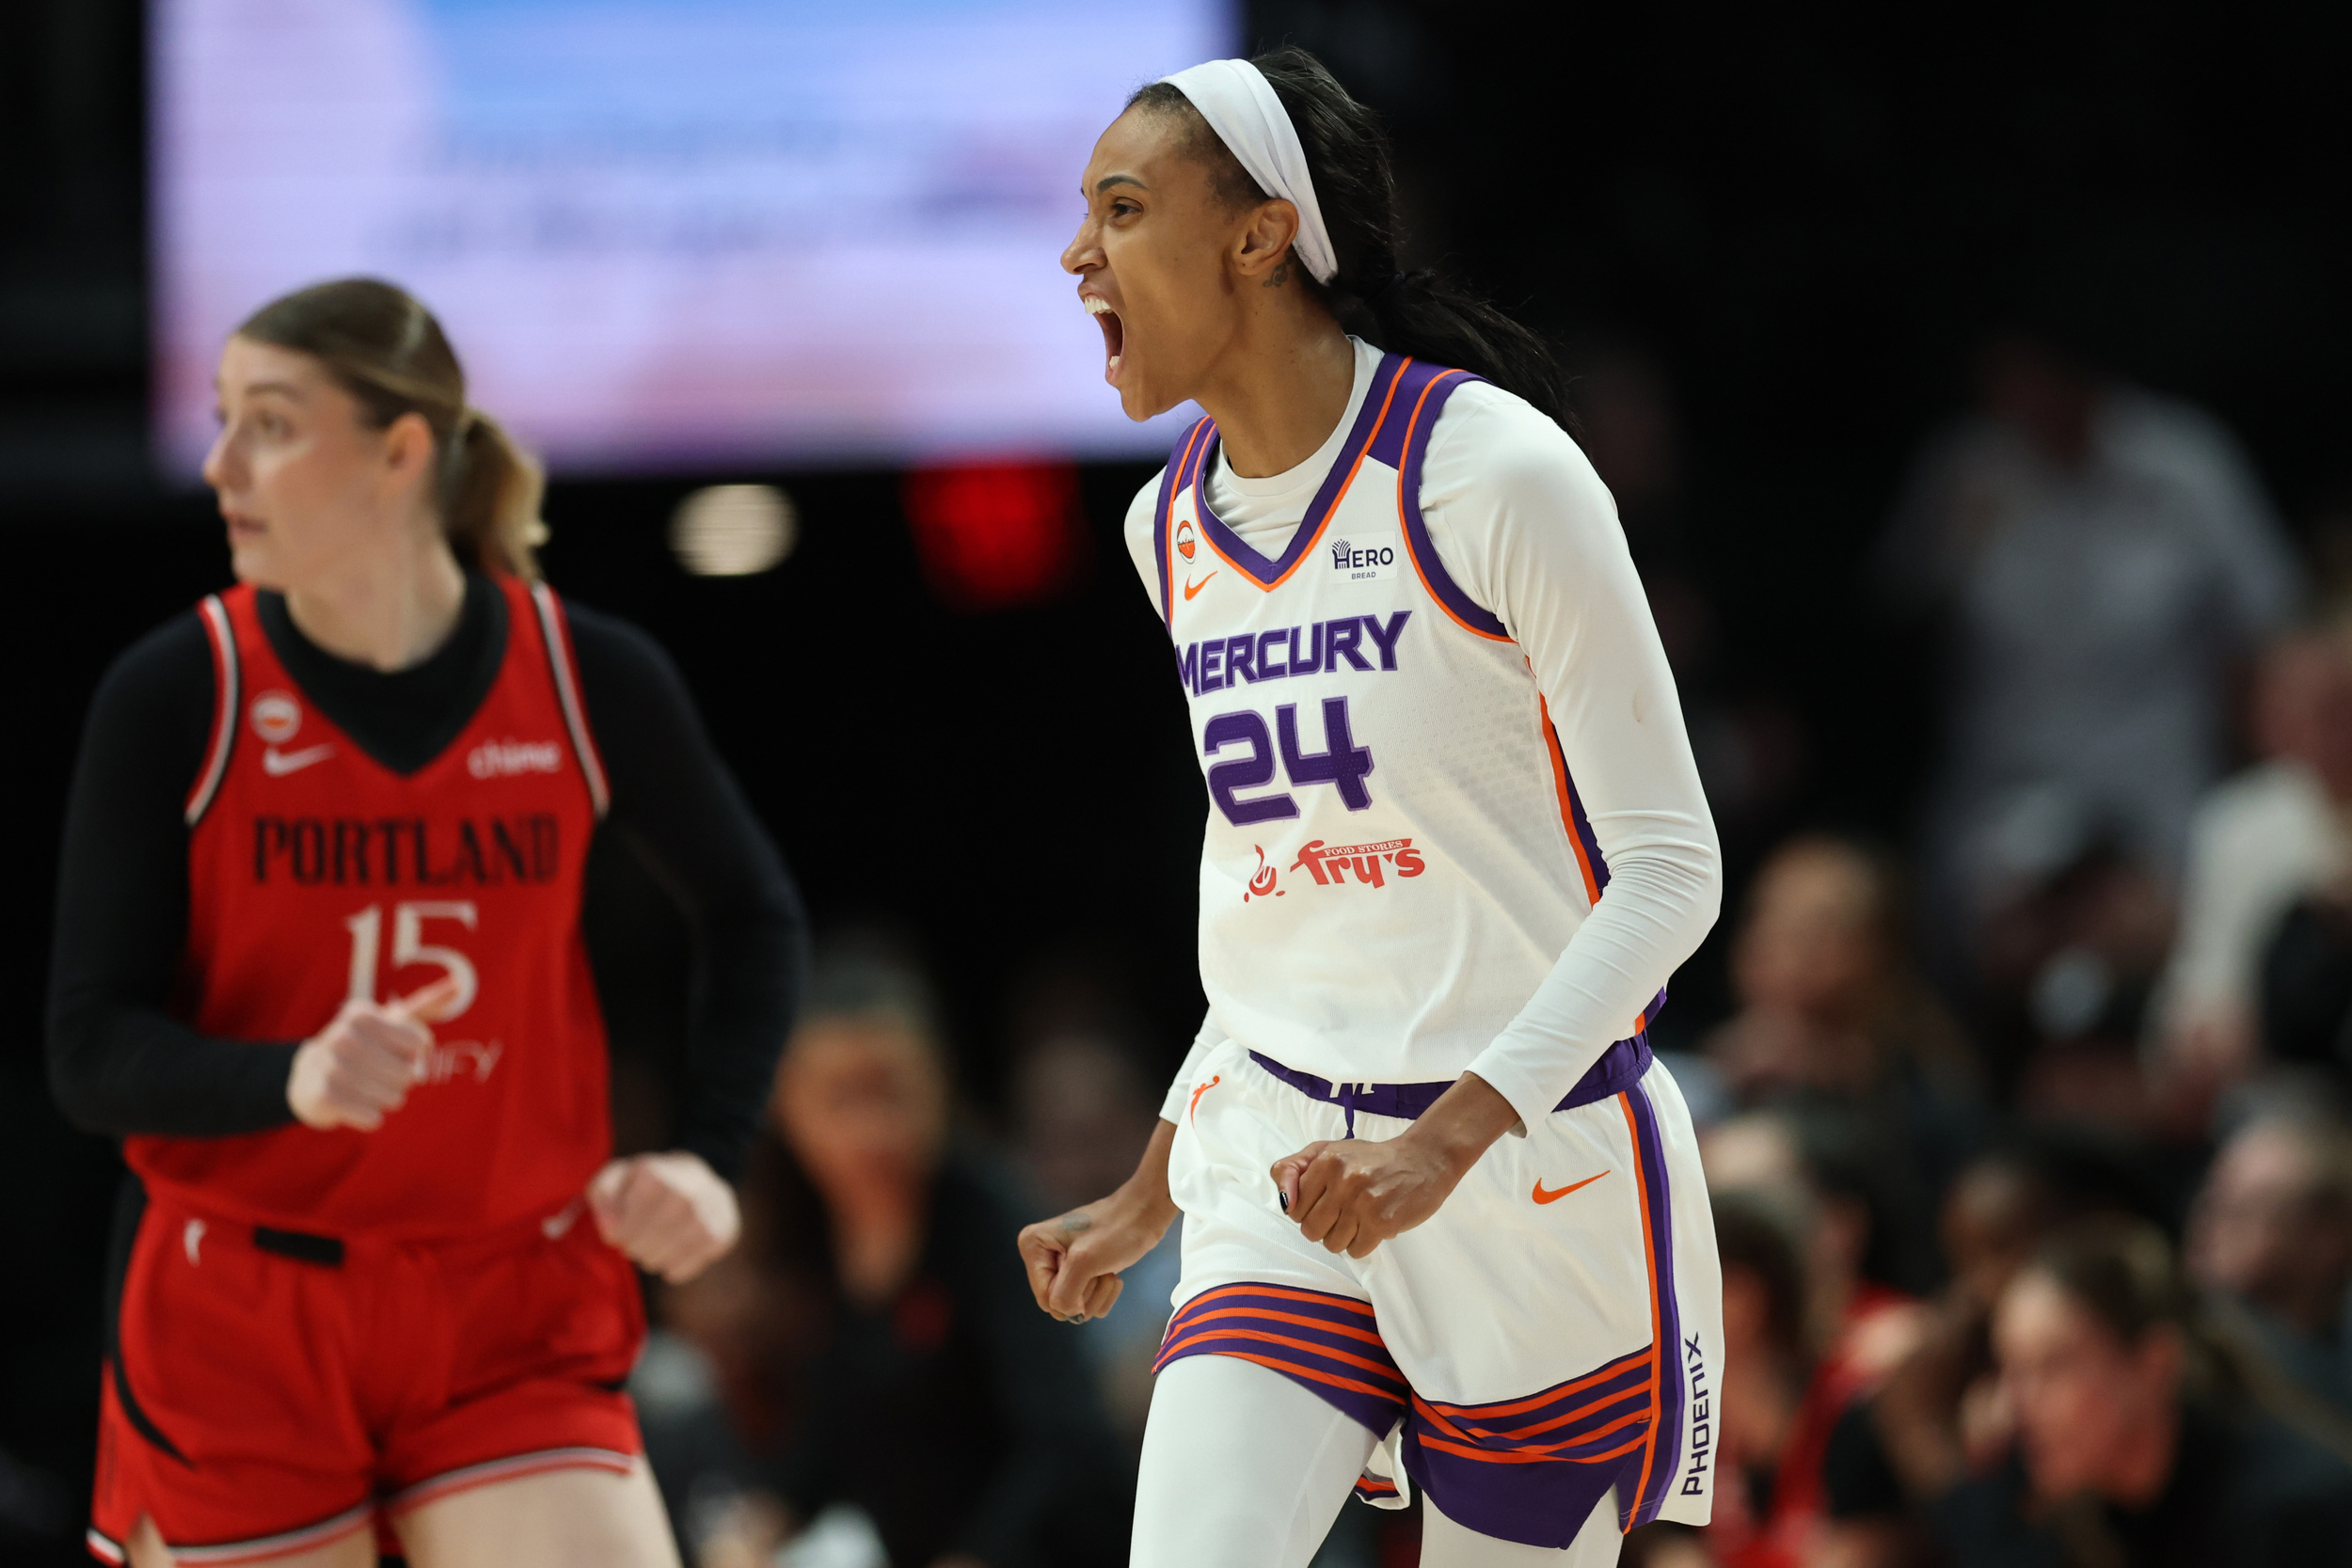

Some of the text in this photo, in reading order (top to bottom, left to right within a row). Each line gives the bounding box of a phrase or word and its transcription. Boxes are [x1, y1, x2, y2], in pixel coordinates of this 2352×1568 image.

[1332, 539, 1394, 569] HERO
[1351, 571, 1376, 580] BREAD
[1176, 610, 1412, 697] MERCURY
[1203, 695, 1375, 827] 24
[252, 814, 560, 886] PORTLAND
[1324, 840, 1404, 857] FOOD STORES
[344, 900, 479, 1023] 15
[1680, 1331, 1709, 1496] PHOENIX
